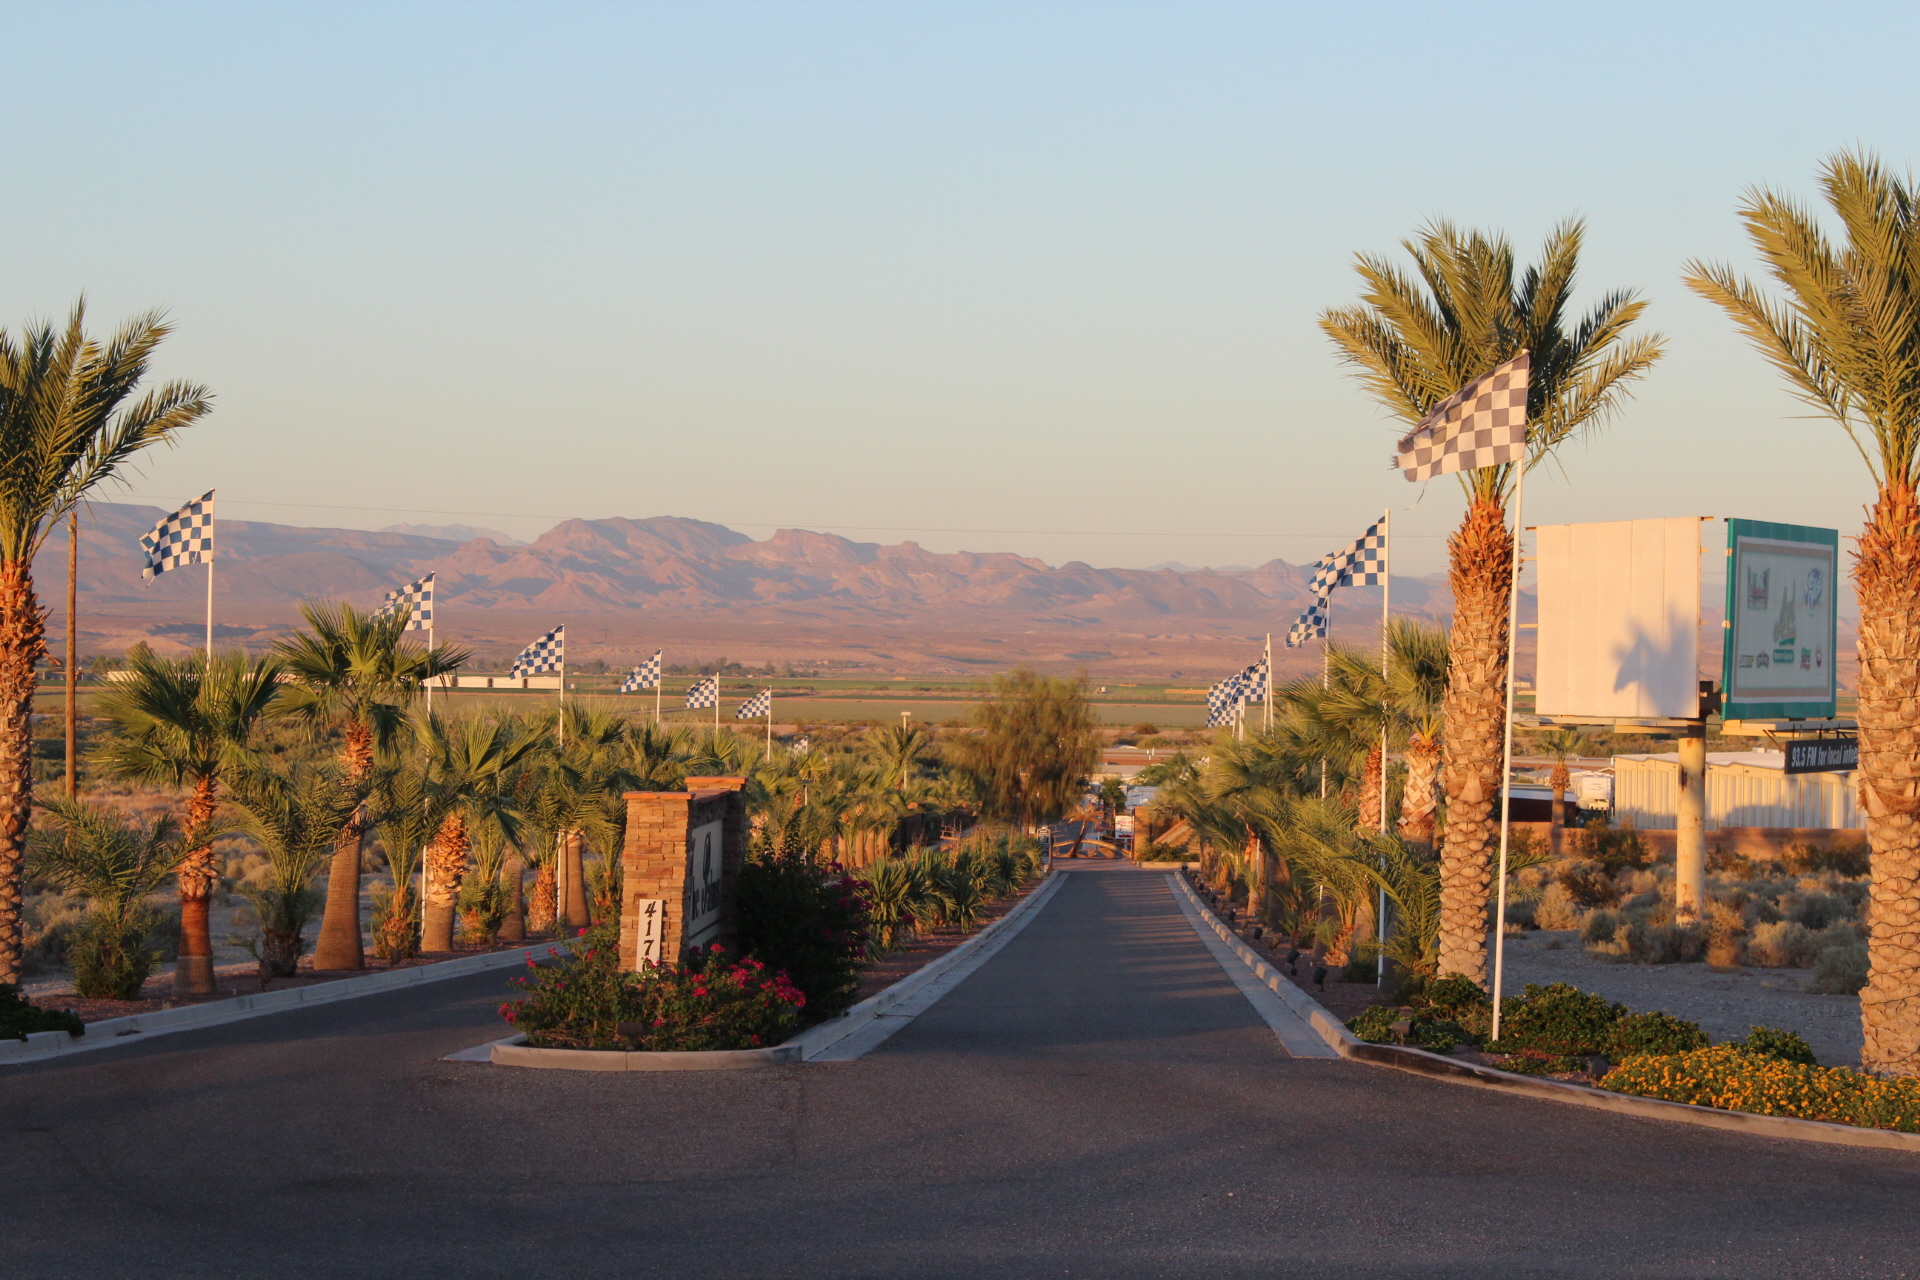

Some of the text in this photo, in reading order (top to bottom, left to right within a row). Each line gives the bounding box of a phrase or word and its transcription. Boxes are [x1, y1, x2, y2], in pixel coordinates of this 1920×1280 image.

[1791, 746, 1806, 768] 93.5
[1806, 746, 1818, 767] FM
[1817, 746, 1827, 766] for
[1827, 745, 1843, 766] local
